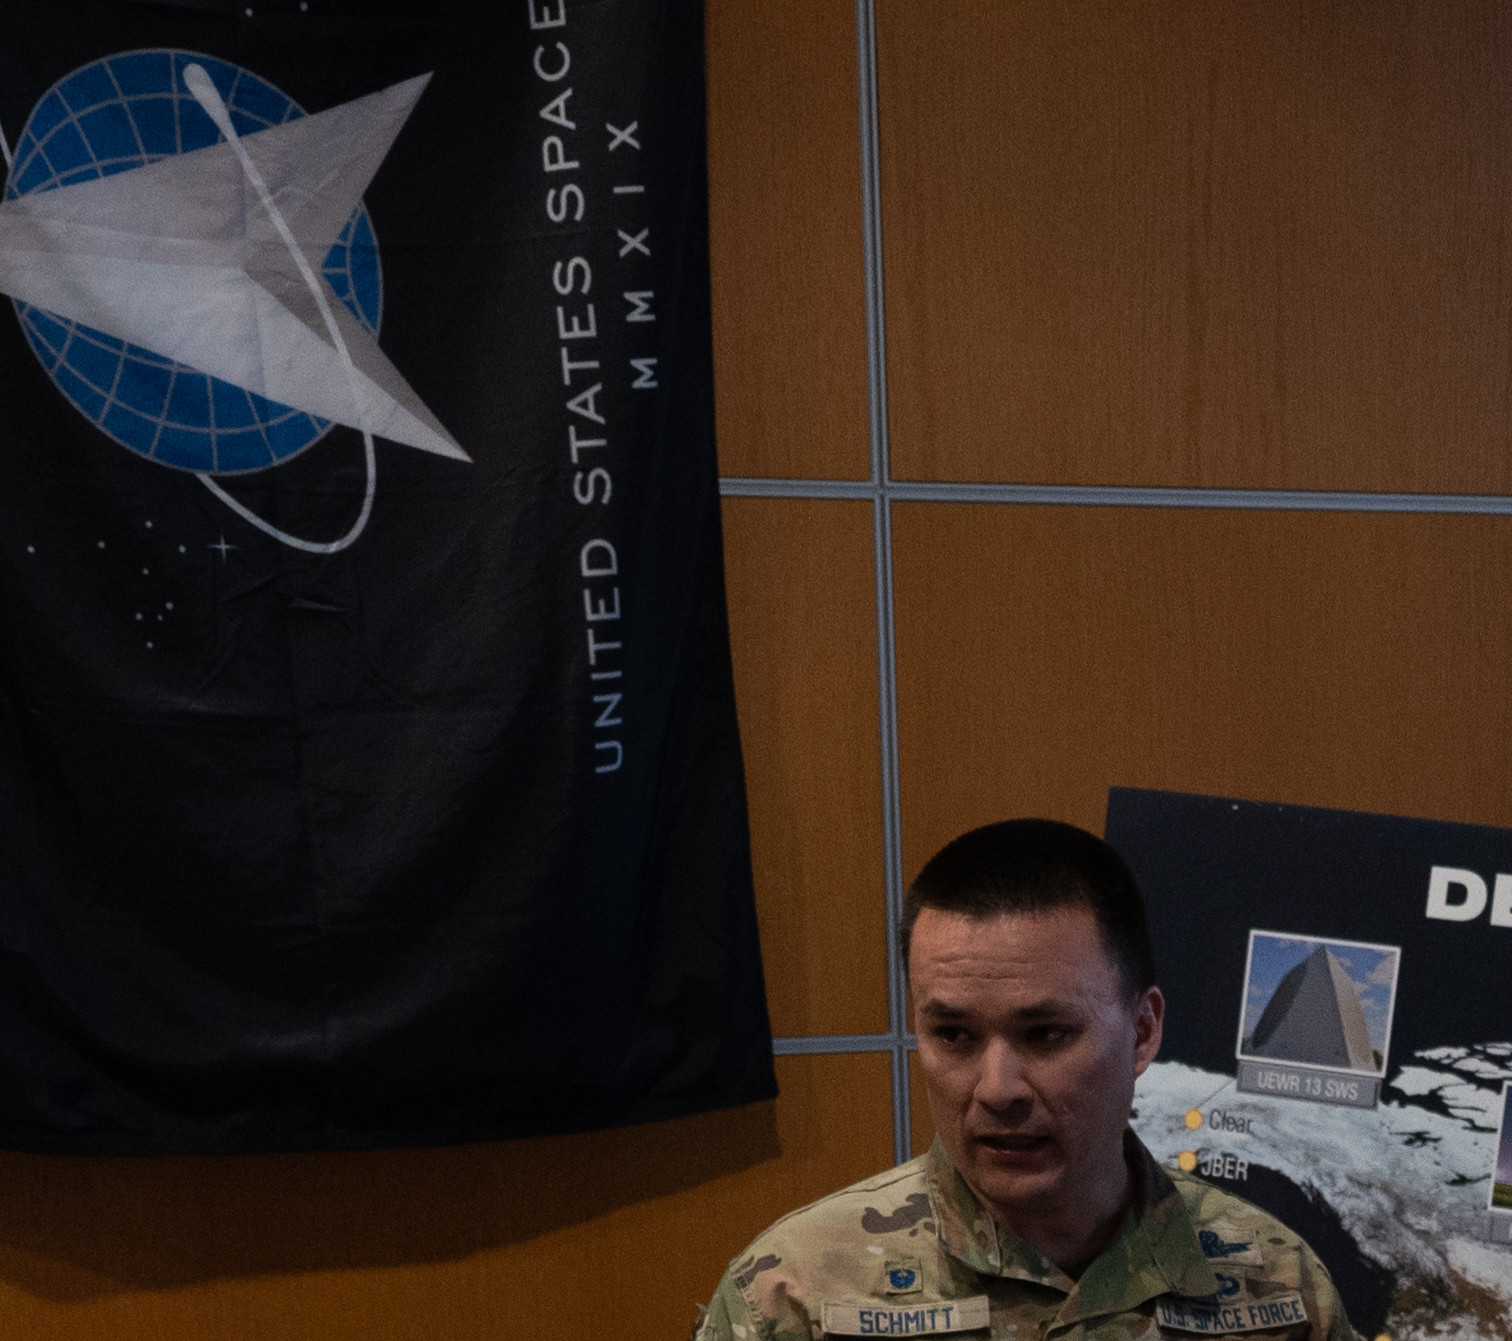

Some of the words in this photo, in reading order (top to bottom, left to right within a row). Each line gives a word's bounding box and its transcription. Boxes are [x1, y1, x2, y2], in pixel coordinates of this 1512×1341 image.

[526, 0, 586, 222] SPACE
[552, 257, 614, 507] STATES
[580, 536, 624, 775] UNITED
[1258, 1070, 1299, 1096] UEWR
[1304, 1076, 1324, 1098] 13
[1326, 1078, 1359, 1101] SWS
[1208, 1109, 1253, 1137] Clear
[1201, 1154, 1249, 1182] JBER
[859, 1307, 954, 1334] SCHMITT
[1194, 1305, 1246, 1331] SPACE
[1249, 1300, 1304, 1325] FORCE
